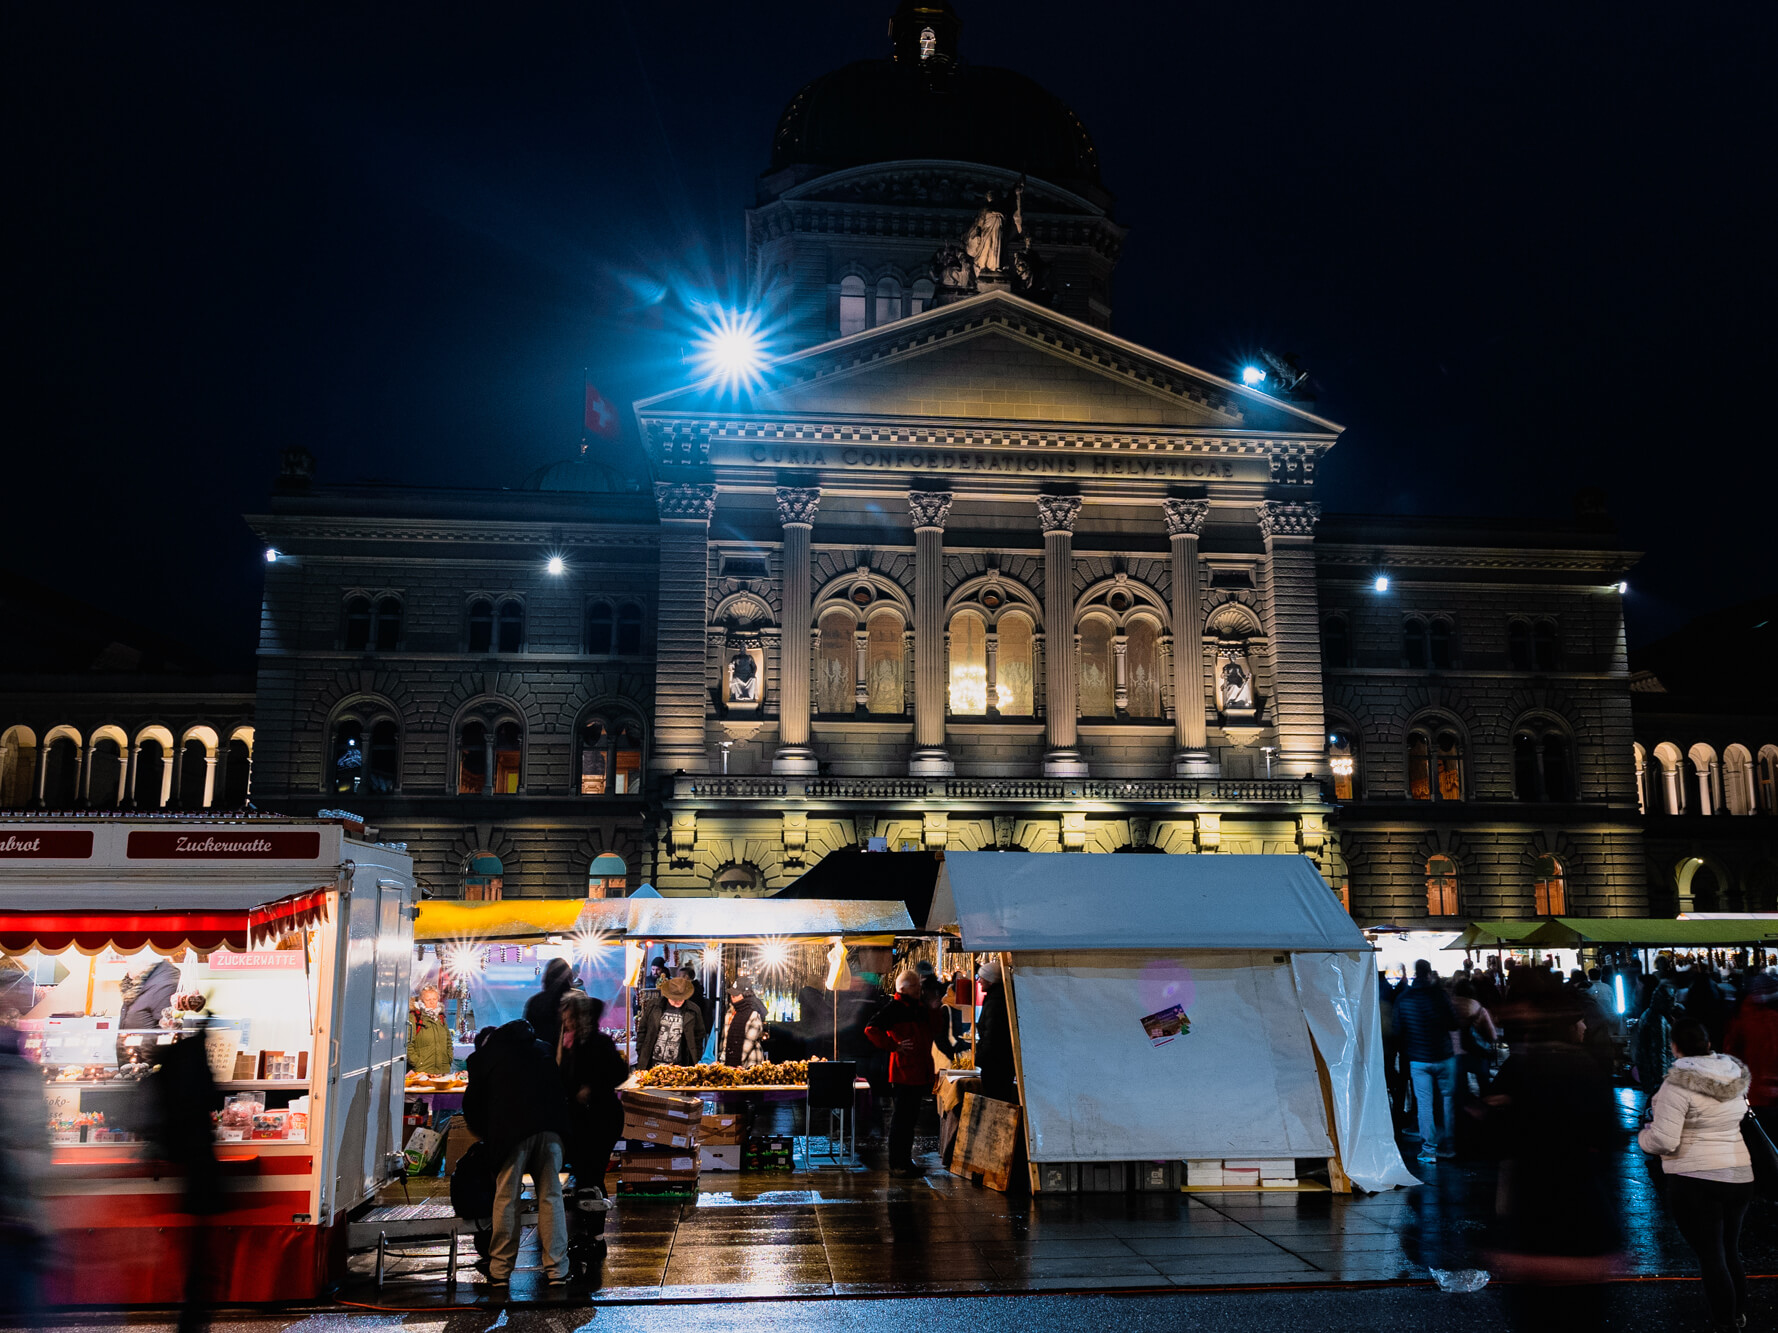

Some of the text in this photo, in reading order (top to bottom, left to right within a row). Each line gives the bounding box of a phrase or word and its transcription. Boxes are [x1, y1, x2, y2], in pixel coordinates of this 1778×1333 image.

[751, 446, 1234, 478] CURIA CONFOEDERATIONIS HELVETICAE
[175, 836, 272, 852] Zuckerwatte
[217, 955, 297, 966] ZUCKERWATTE
